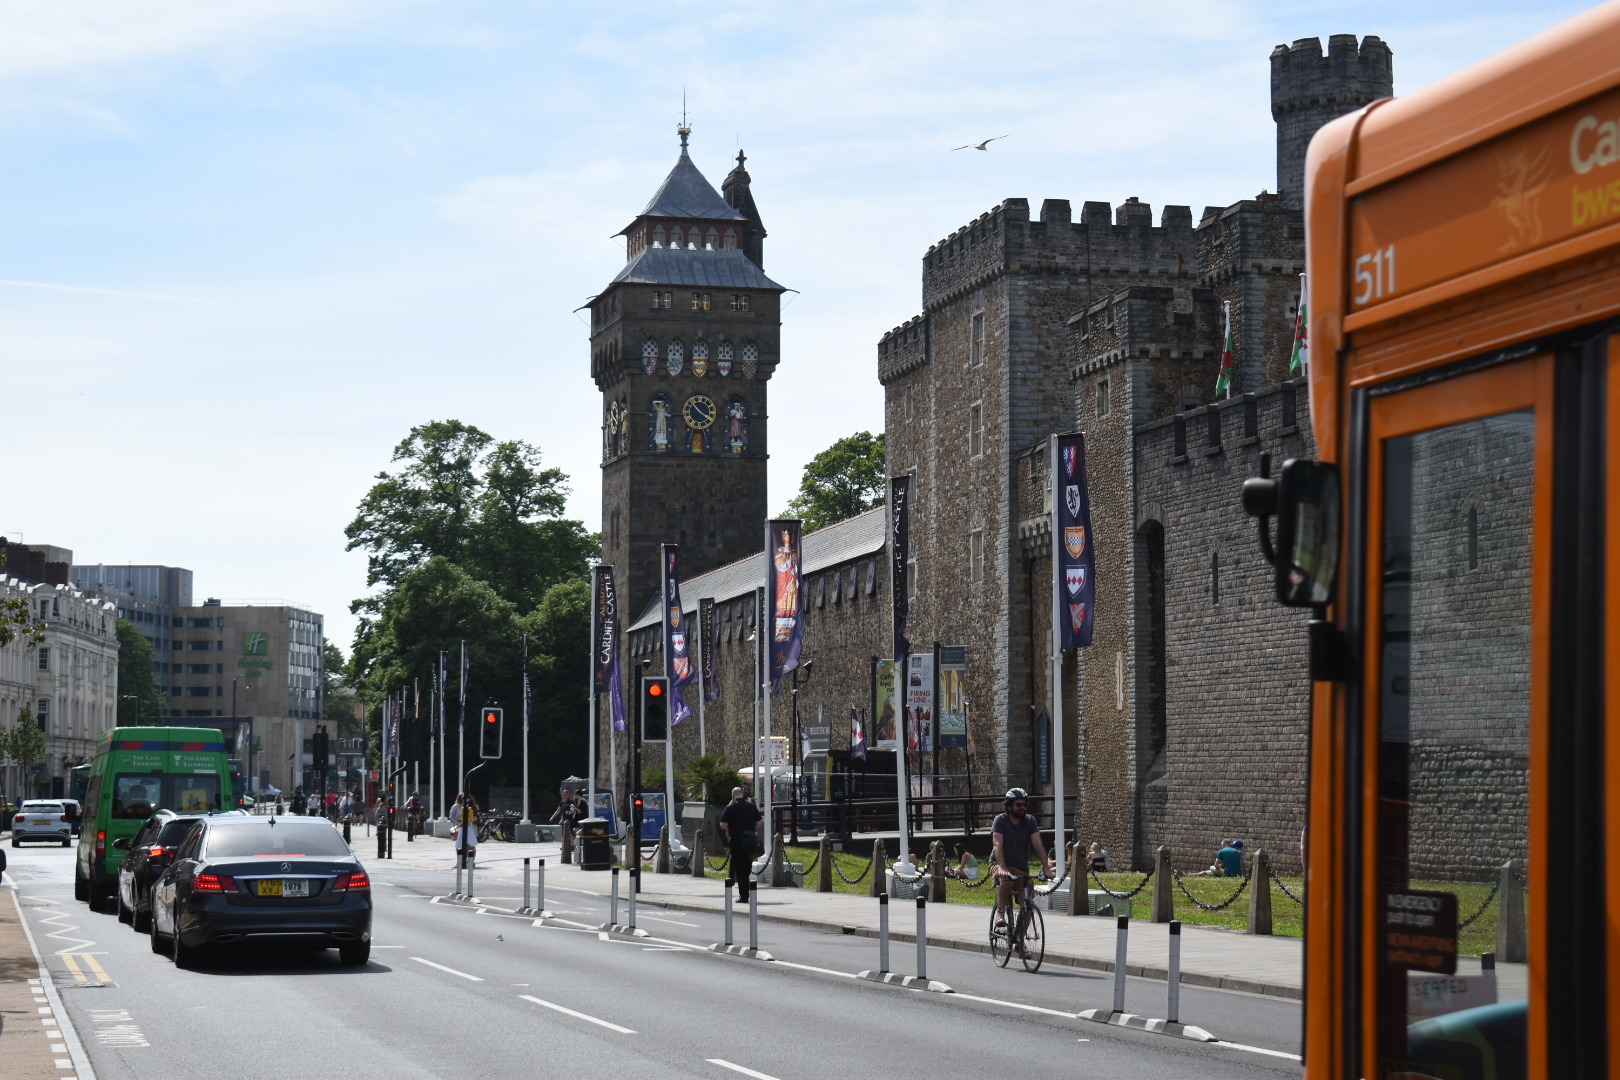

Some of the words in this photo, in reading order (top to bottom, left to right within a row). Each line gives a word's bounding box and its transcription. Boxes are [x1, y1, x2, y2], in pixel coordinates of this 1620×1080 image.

[1570, 115, 1620, 174] Ca
[1572, 179, 1620, 227] bws
[1354, 244, 1396, 305] 511
[604, 573, 614, 615] CASTLE
[601, 618, 613, 664] CARDIFF
[238, 658, 273, 670] Holiday
[880, 673, 895, 681] Cefn
[880, 681, 892, 689] byd
[262, 886, 280, 894] XYJ
[284, 882, 302, 891] 1979
[1413, 978, 1468, 997] SEATED
